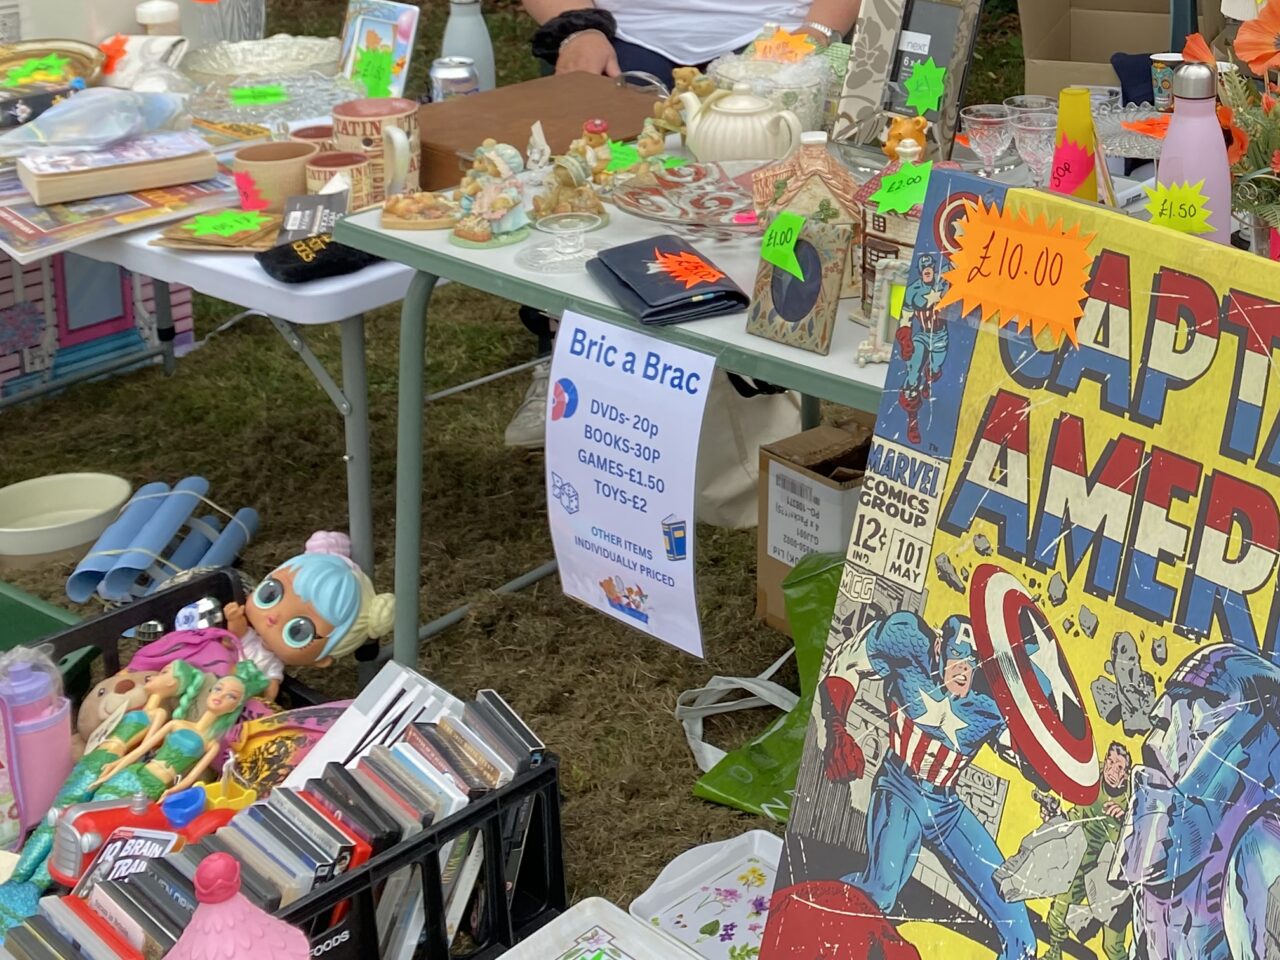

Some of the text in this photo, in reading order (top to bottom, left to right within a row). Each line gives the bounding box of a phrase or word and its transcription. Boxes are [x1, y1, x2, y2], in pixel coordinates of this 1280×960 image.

[906, 41, 928, 53] next
[1158, 197, 1198, 220] £1.50
[766, 226, 794, 248] £1.00
[966, 229, 1064, 287] £10.00
[569, 327, 701, 395] Bric a Brac
[590, 398, 659, 439] DVDs- 20p
[584, 424, 661, 464] BOOKS-30P
[578, 448, 665, 494] GAMES-£1.50
[866, 441, 941, 499] MARVEL
[594, 479, 648, 513] TOYS-£2
[859, 491, 927, 529] GROUP
[863, 475, 930, 515] COMICS
[574, 535, 675, 588] INDIVIDUALLY PRICED
[591, 526, 653, 561] OTHER ITEMS
[896, 537, 925, 570] 101
[841, 565, 876, 601] MCG
[889, 561, 921, 584] MAY
[118, 838, 164, 858] BRAIN
